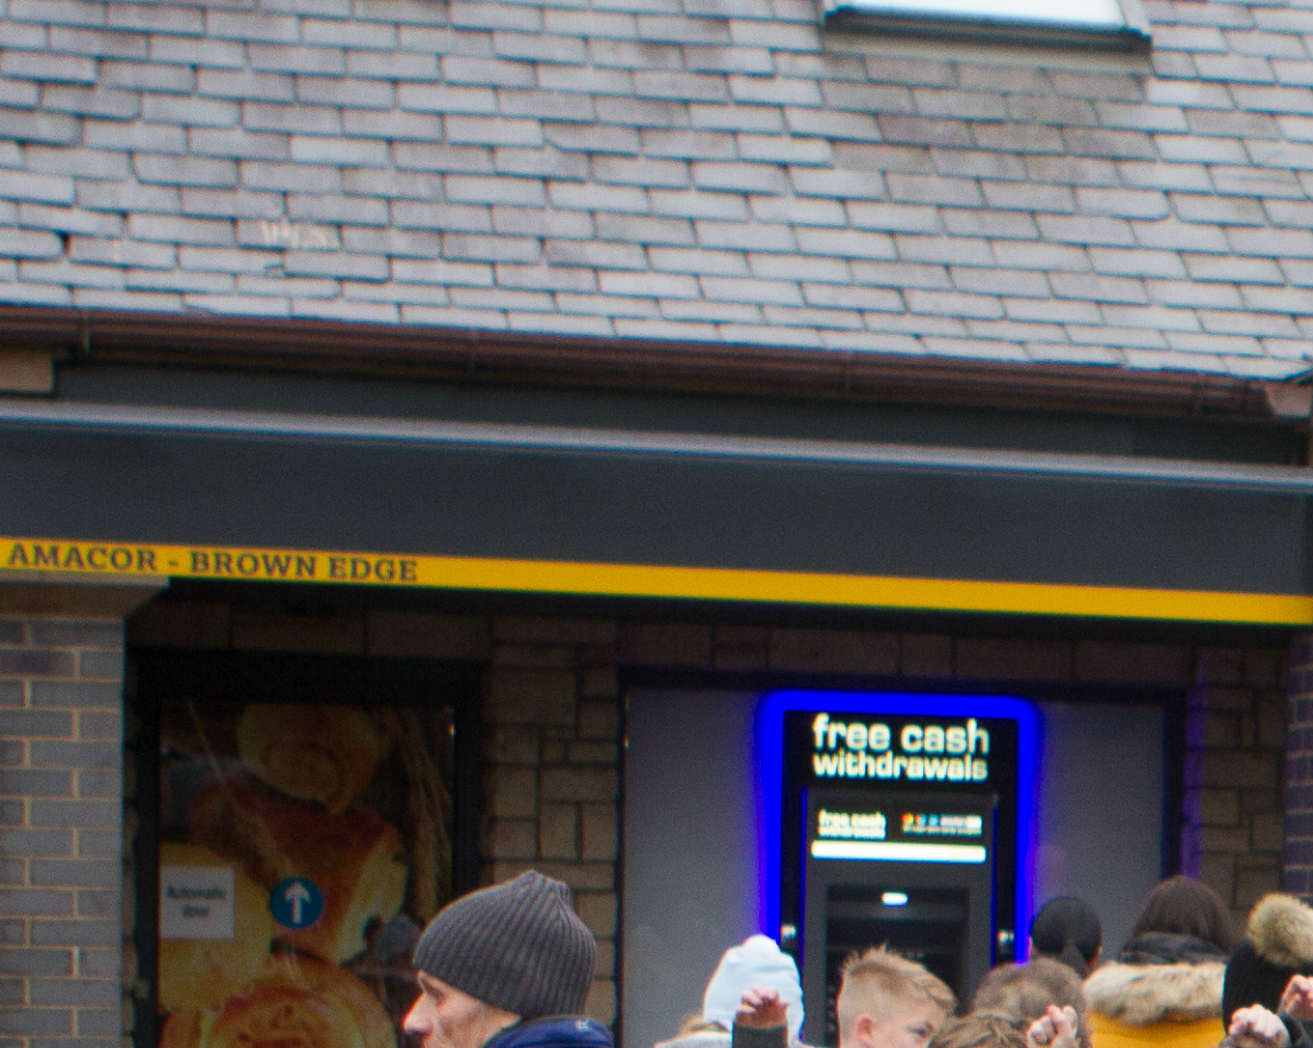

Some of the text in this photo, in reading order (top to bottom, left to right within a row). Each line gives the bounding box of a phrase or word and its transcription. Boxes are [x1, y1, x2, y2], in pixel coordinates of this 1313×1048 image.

[8, 542, 158, 572] AMACOR
[190, 550, 318, 579] BROWN
[328, 557, 418, 582] EDGE
[813, 712, 990, 755] free cash
[812, 749, 989, 782] withdrawals
